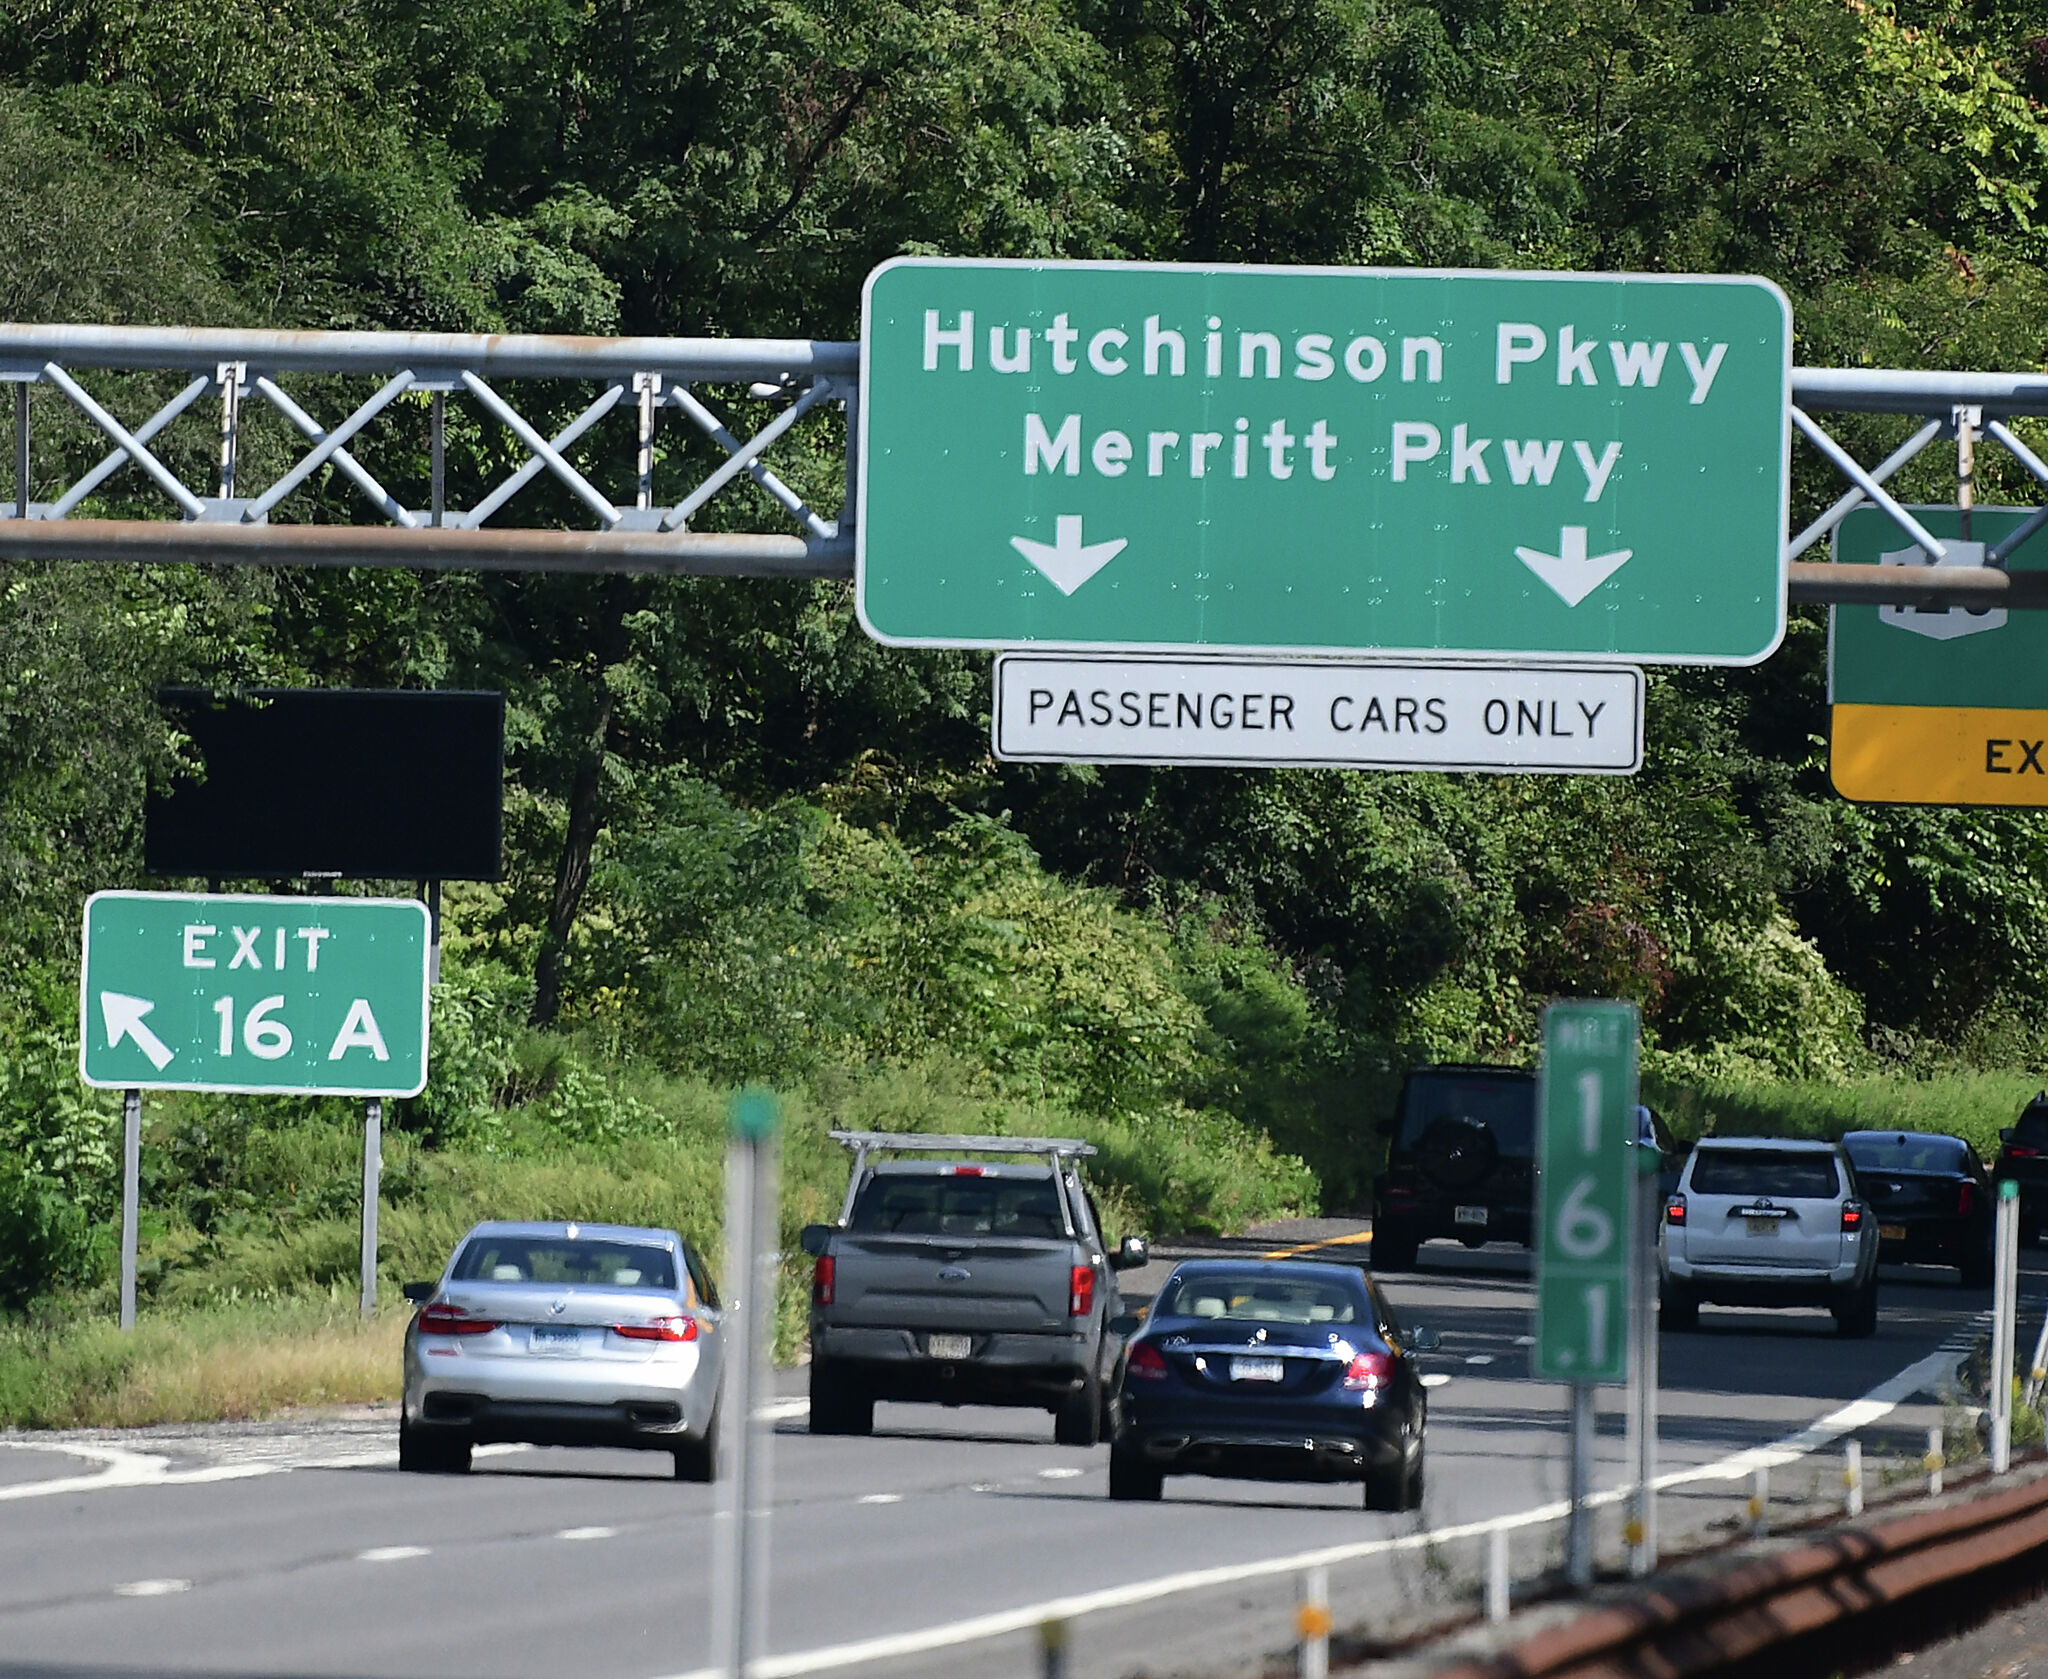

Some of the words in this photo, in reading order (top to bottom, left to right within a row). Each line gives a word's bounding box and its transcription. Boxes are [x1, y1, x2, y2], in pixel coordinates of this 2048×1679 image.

[923, 309, 1443, 383] Hutchinson
[1496, 322, 1728, 405] Pkwy
[1023, 412, 1338, 481] Merritt
[1392, 421, 1623, 503] Pkwy
[1028, 688, 1295, 732] PASSENGER
[1329, 695, 1448, 735] CARS
[1483, 697, 1606, 739] ONLY
[182, 924, 331, 972] EXIT
[212, 994, 294, 1060] 16
[327, 998, 391, 1062] A
